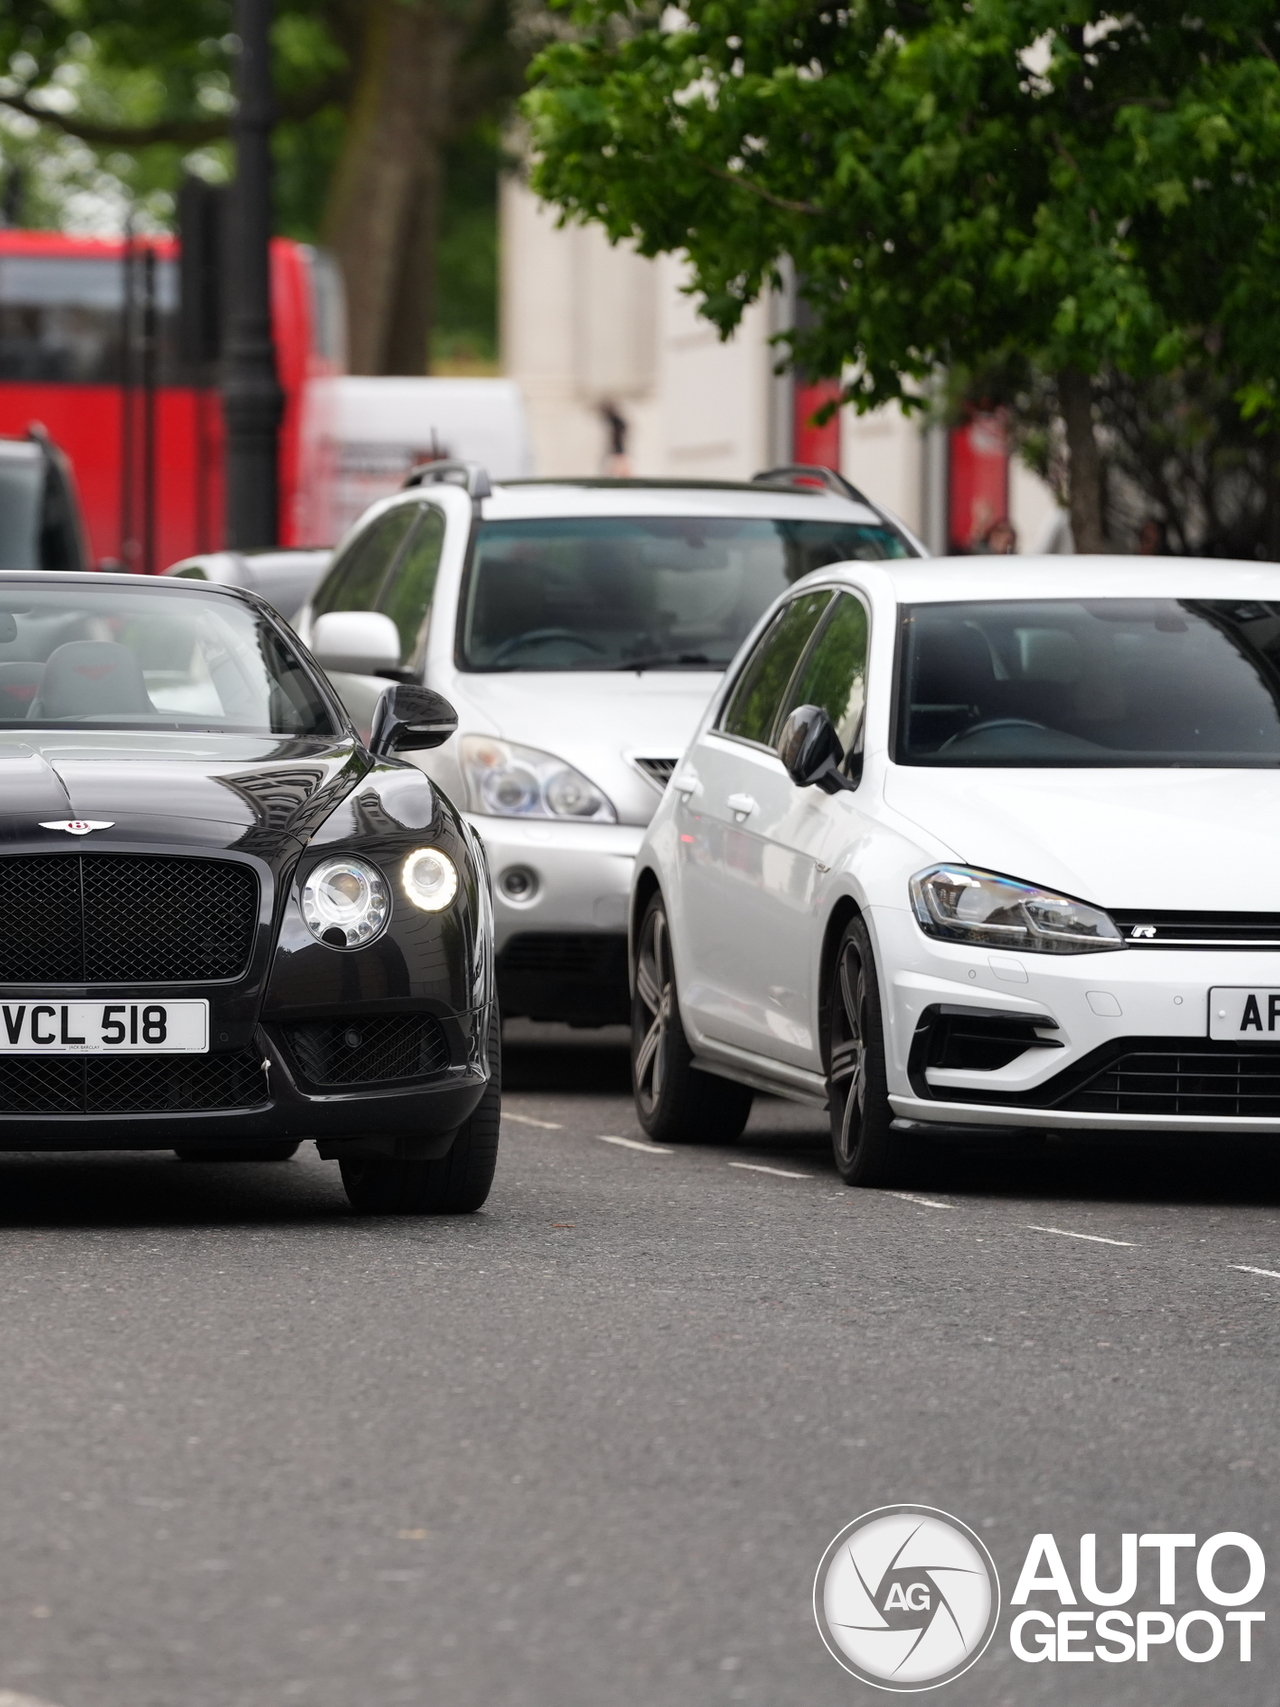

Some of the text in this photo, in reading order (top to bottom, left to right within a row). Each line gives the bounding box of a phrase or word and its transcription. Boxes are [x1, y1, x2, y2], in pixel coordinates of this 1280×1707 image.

[1131, 925, 1157, 938] R
[1, 1005, 167, 1045] VCL 518
